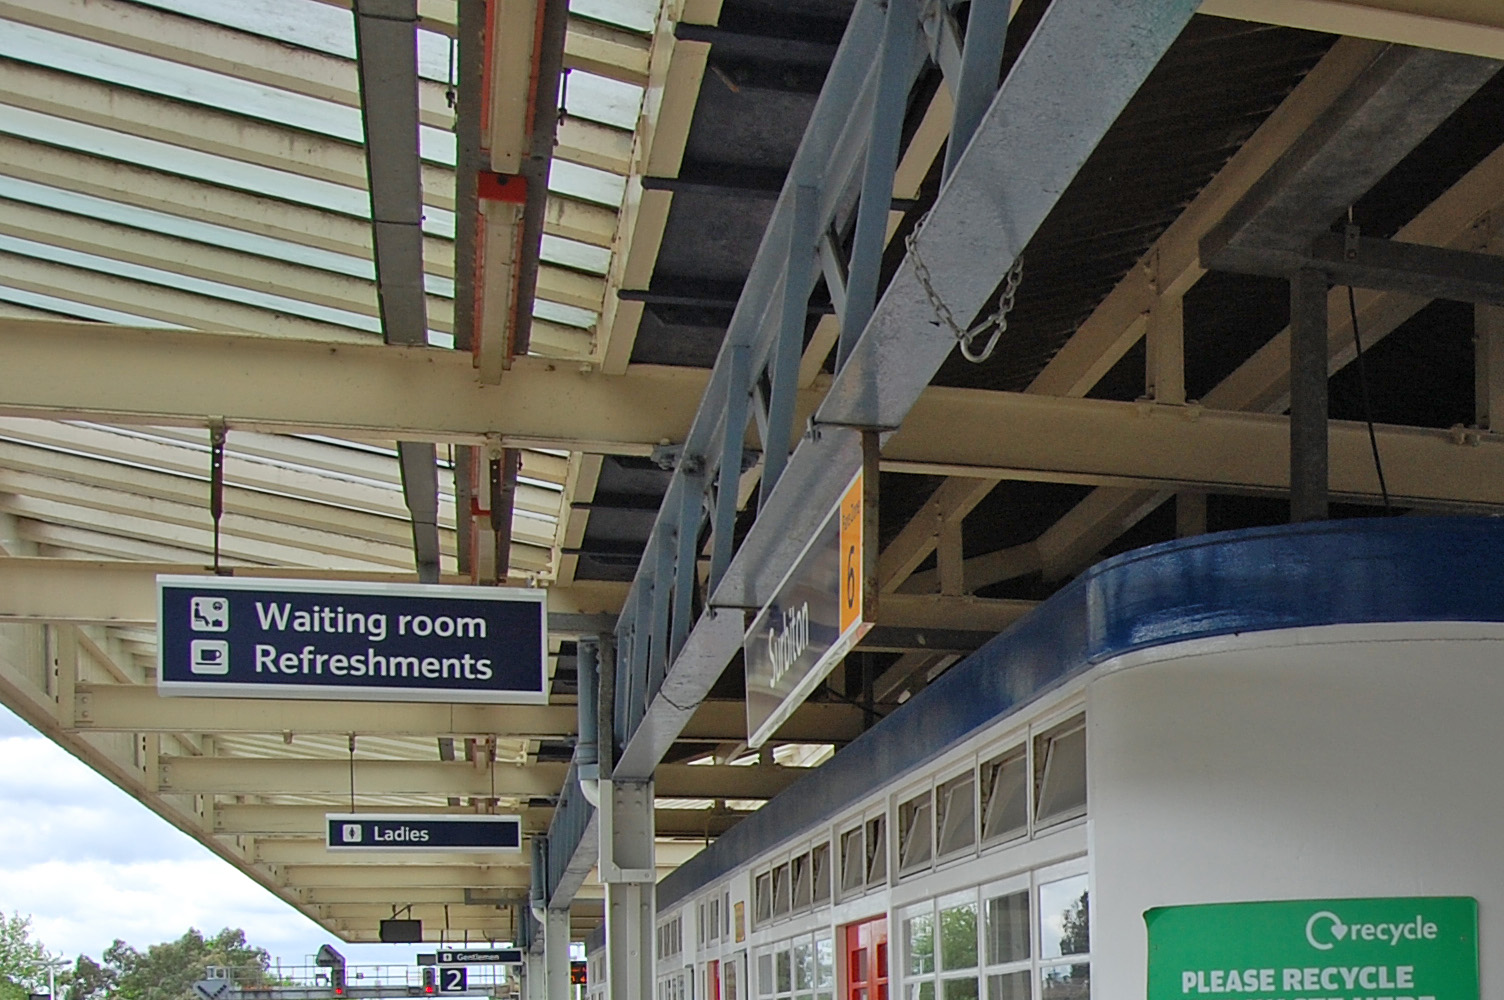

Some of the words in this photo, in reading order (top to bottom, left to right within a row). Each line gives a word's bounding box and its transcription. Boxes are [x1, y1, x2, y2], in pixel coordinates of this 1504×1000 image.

[255, 603, 387, 641] Waiting
[398, 614, 487, 638] room
[769, 601, 809, 688] Surbiton
[255, 644, 493, 681] Refreshments
[373, 825, 429, 842] Ladies
[1351, 915, 1438, 946] recycle
[457, 952, 499, 962] Gentlemen
[446, 971, 462, 990] 2
[1182, 968, 1275, 993] PLEASE
[1282, 966, 1414, 992] RECYCLE
